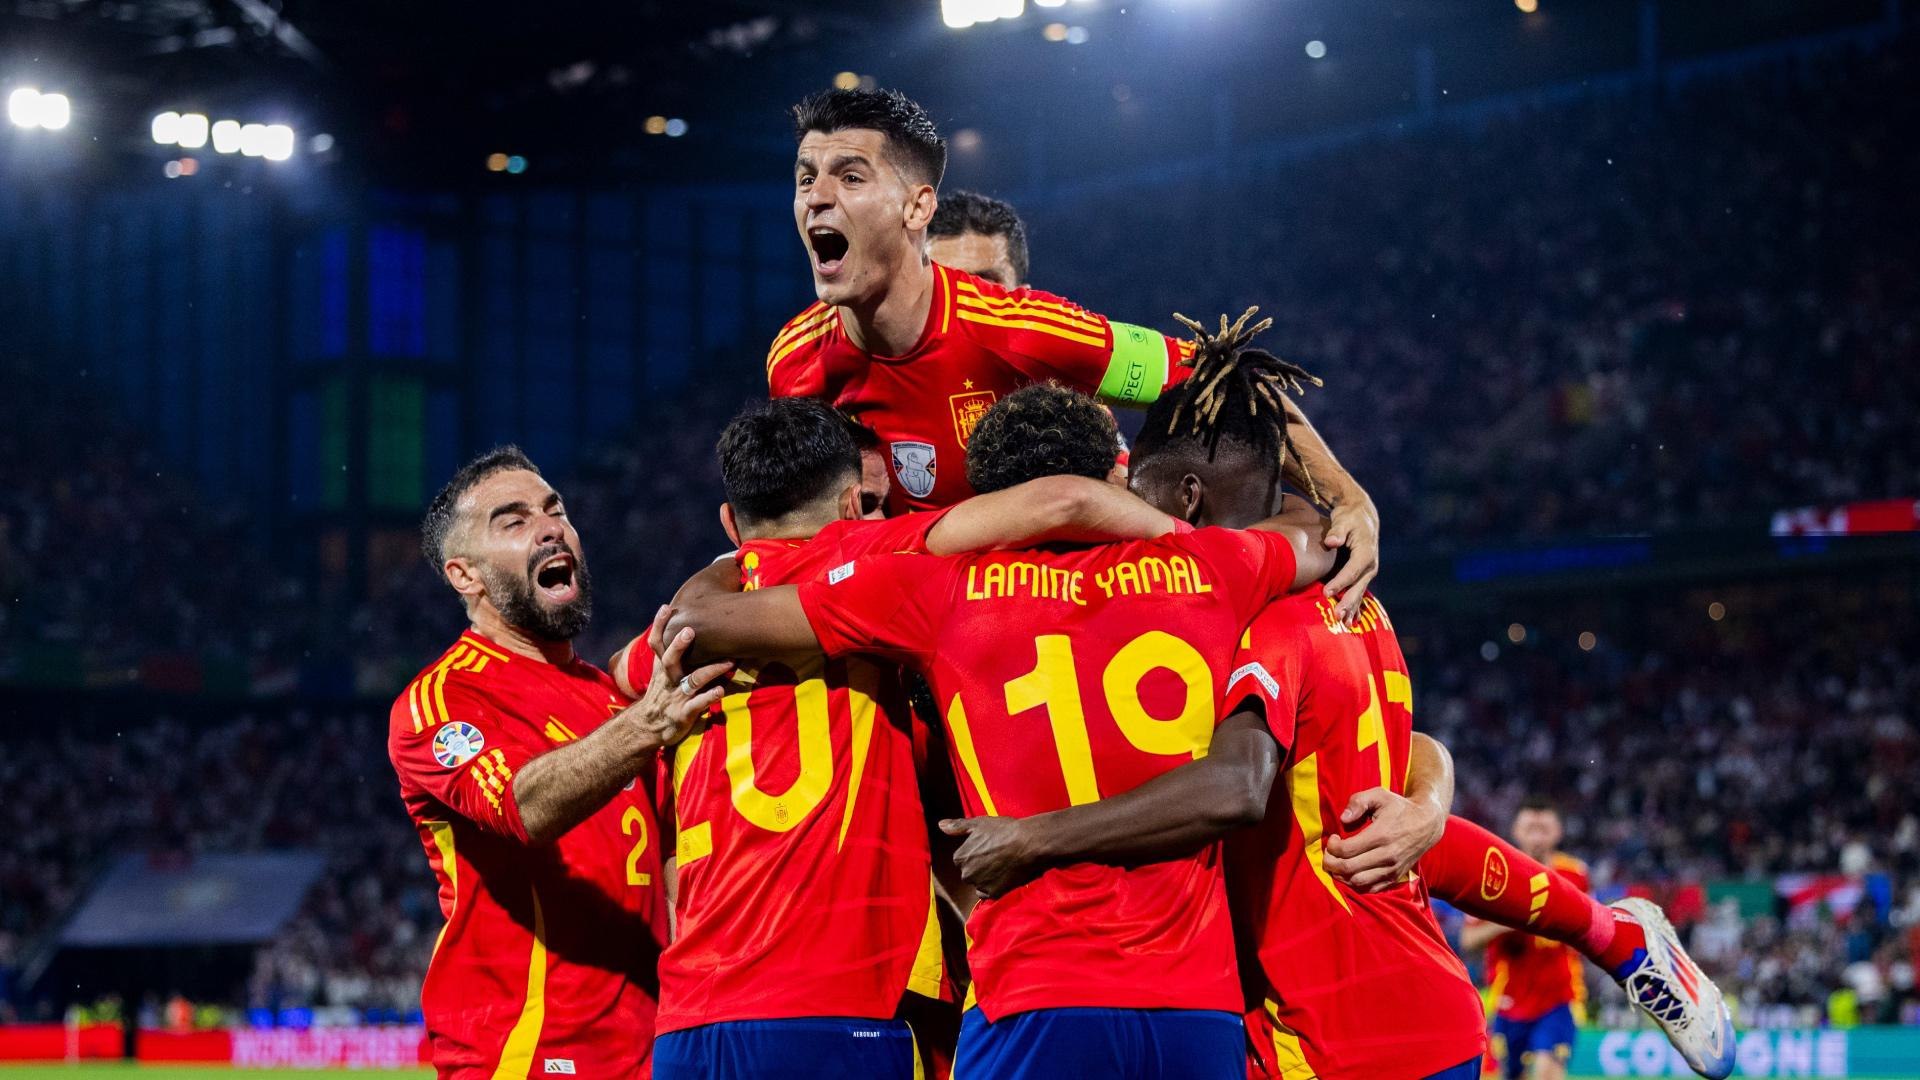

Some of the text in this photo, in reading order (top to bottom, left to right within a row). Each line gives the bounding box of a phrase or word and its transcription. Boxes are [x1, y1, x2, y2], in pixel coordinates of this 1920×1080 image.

[1121, 361, 1144, 401] SPECT
[966, 555, 1212, 606] LAMINE YAMAL
[1003, 630, 1215, 807] 19
[621, 806, 651, 886] 2
